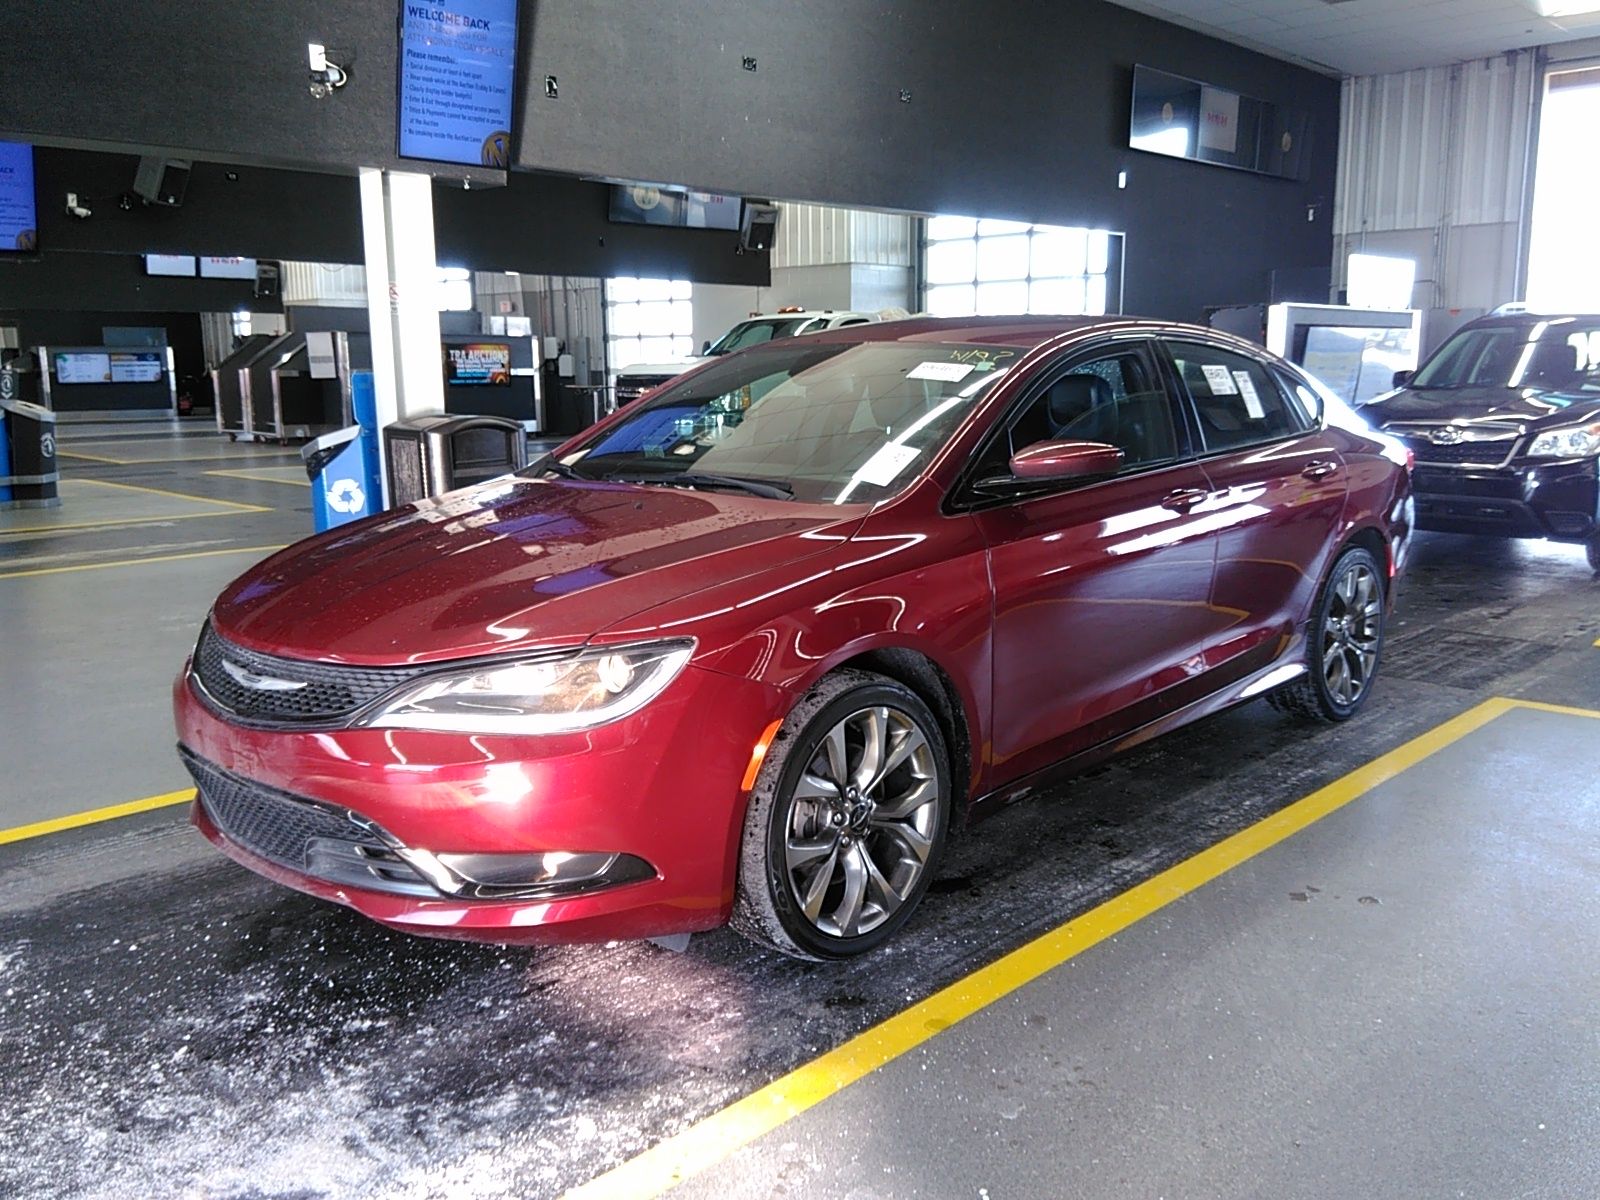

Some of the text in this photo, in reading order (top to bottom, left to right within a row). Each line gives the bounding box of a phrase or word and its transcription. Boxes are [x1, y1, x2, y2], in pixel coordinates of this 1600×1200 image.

[408, 5, 491, 31] WELCOME BACK
[406, 48, 426, 59] Please
[468, 350, 509, 364] AUCTIONS
